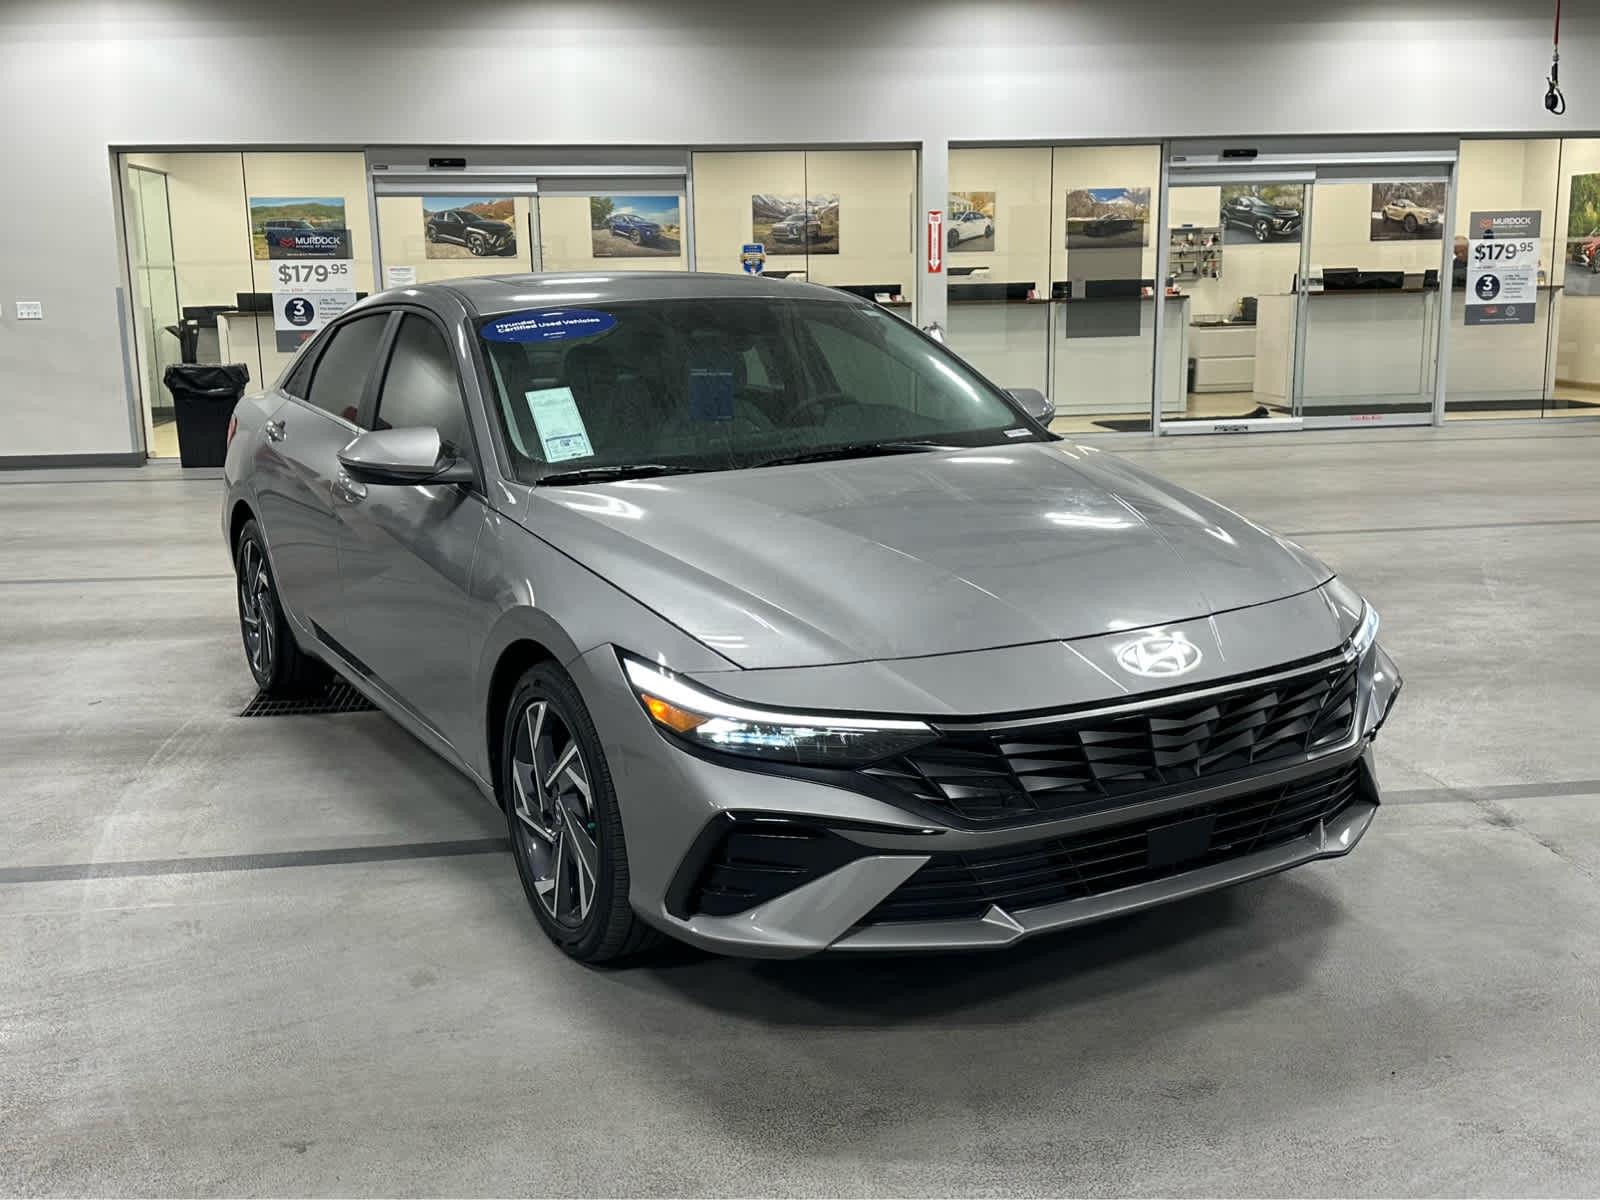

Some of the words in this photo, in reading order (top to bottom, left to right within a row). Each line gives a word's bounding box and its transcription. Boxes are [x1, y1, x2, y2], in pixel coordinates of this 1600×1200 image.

[1492, 216, 1532, 225] MURDOCK
[295, 236, 341, 245] MURDOCK
[1474, 241, 1534, 262] $179.95
[278, 263, 348, 285] $179.95
[1482, 276, 1493, 291] 3
[293, 300, 305, 316] 3
[495, 319, 536, 329] Hyundai
[497, 323, 538, 333] Certified
[538, 320, 561, 328] Used
